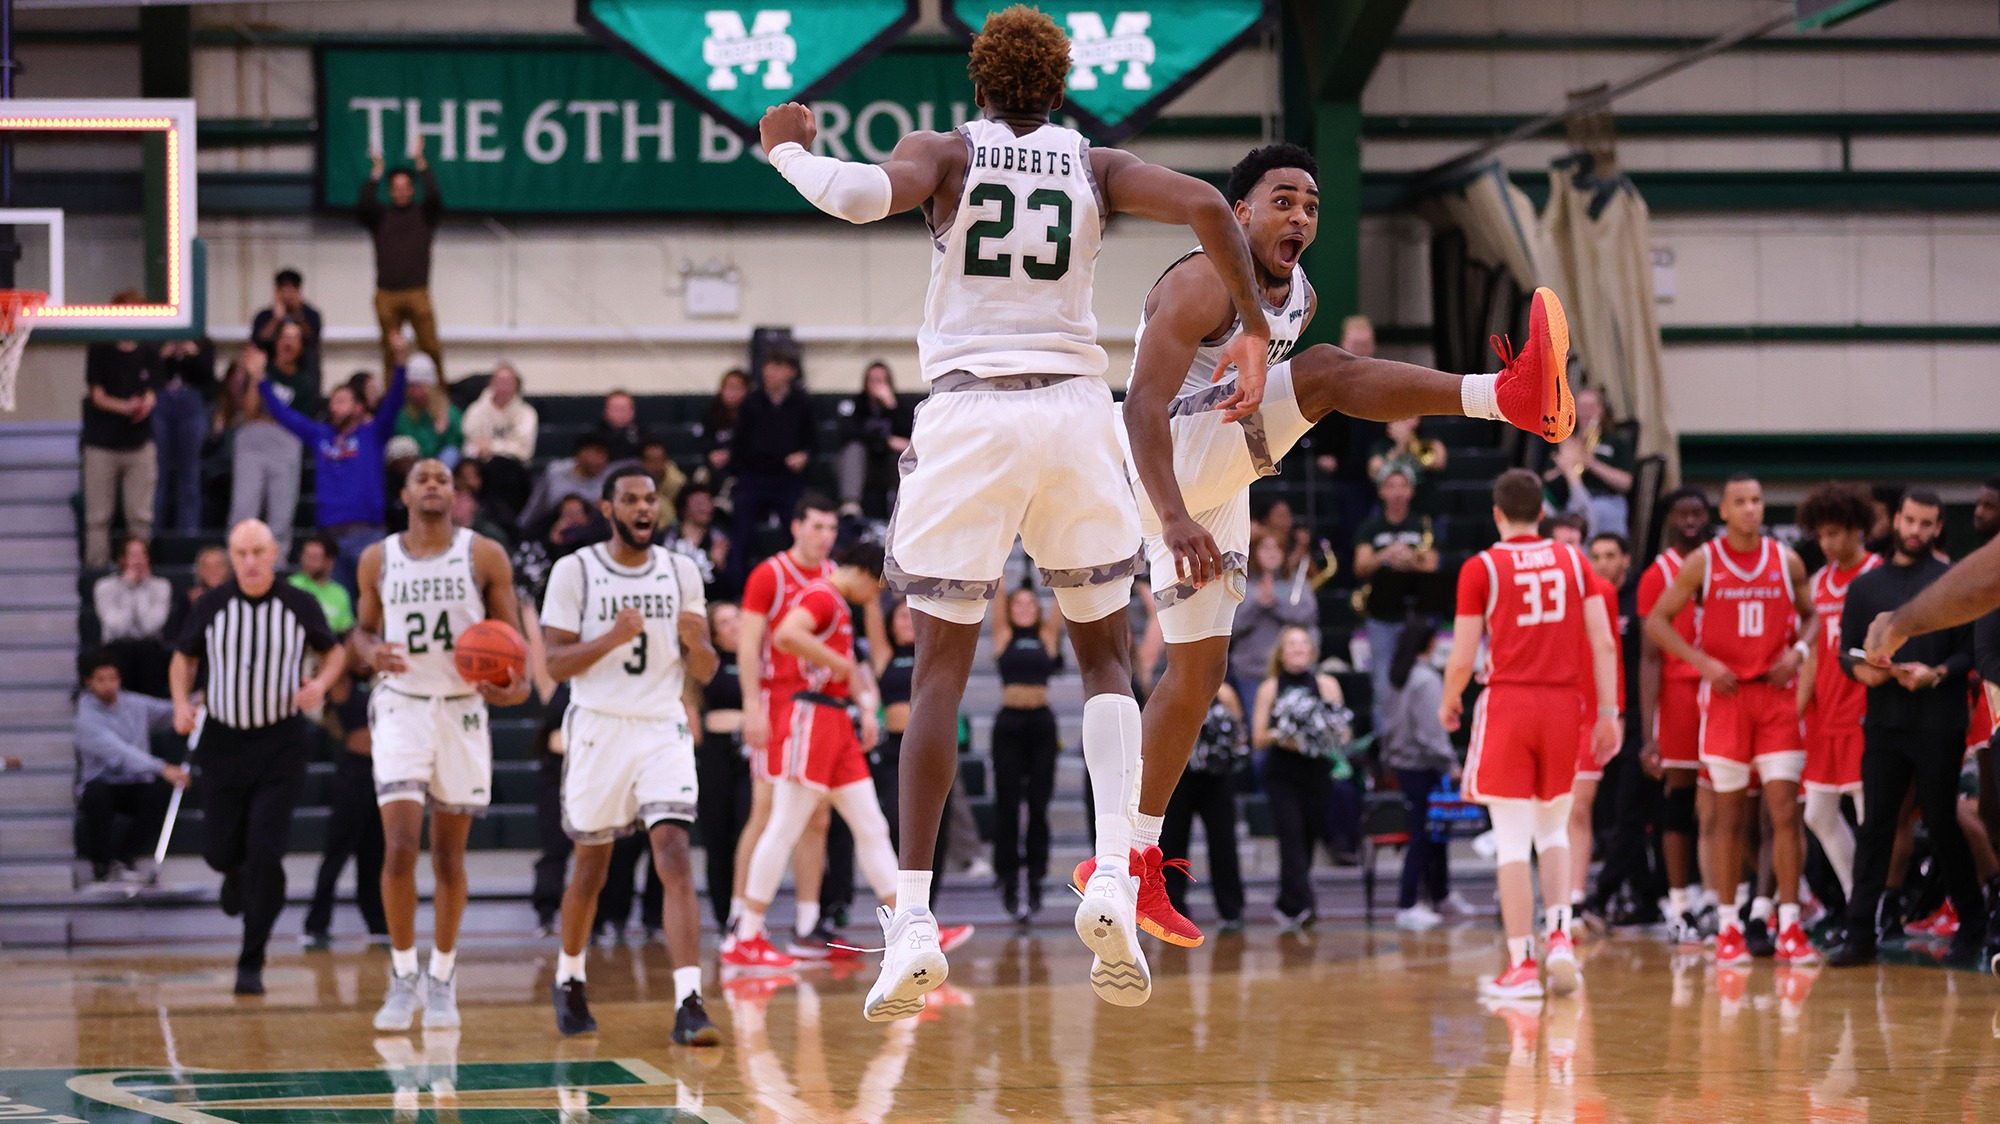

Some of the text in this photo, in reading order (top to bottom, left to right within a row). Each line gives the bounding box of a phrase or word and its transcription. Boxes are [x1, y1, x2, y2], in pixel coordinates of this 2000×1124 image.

[704, 9, 793, 91] M
[349, 97, 506, 163] THE
[523, 100, 676, 164] 6TH
[975, 146, 1071, 176] ROBERTS
[963, 182, 1073, 281] 23
[1510, 546, 1557, 571] LONG
[390, 577, 466, 605] JASPERS
[1513, 568, 1567, 627] 33
[405, 609, 455, 656] 24
[1737, 600, 1765, 638] 10
[623, 630, 649, 676] 3
